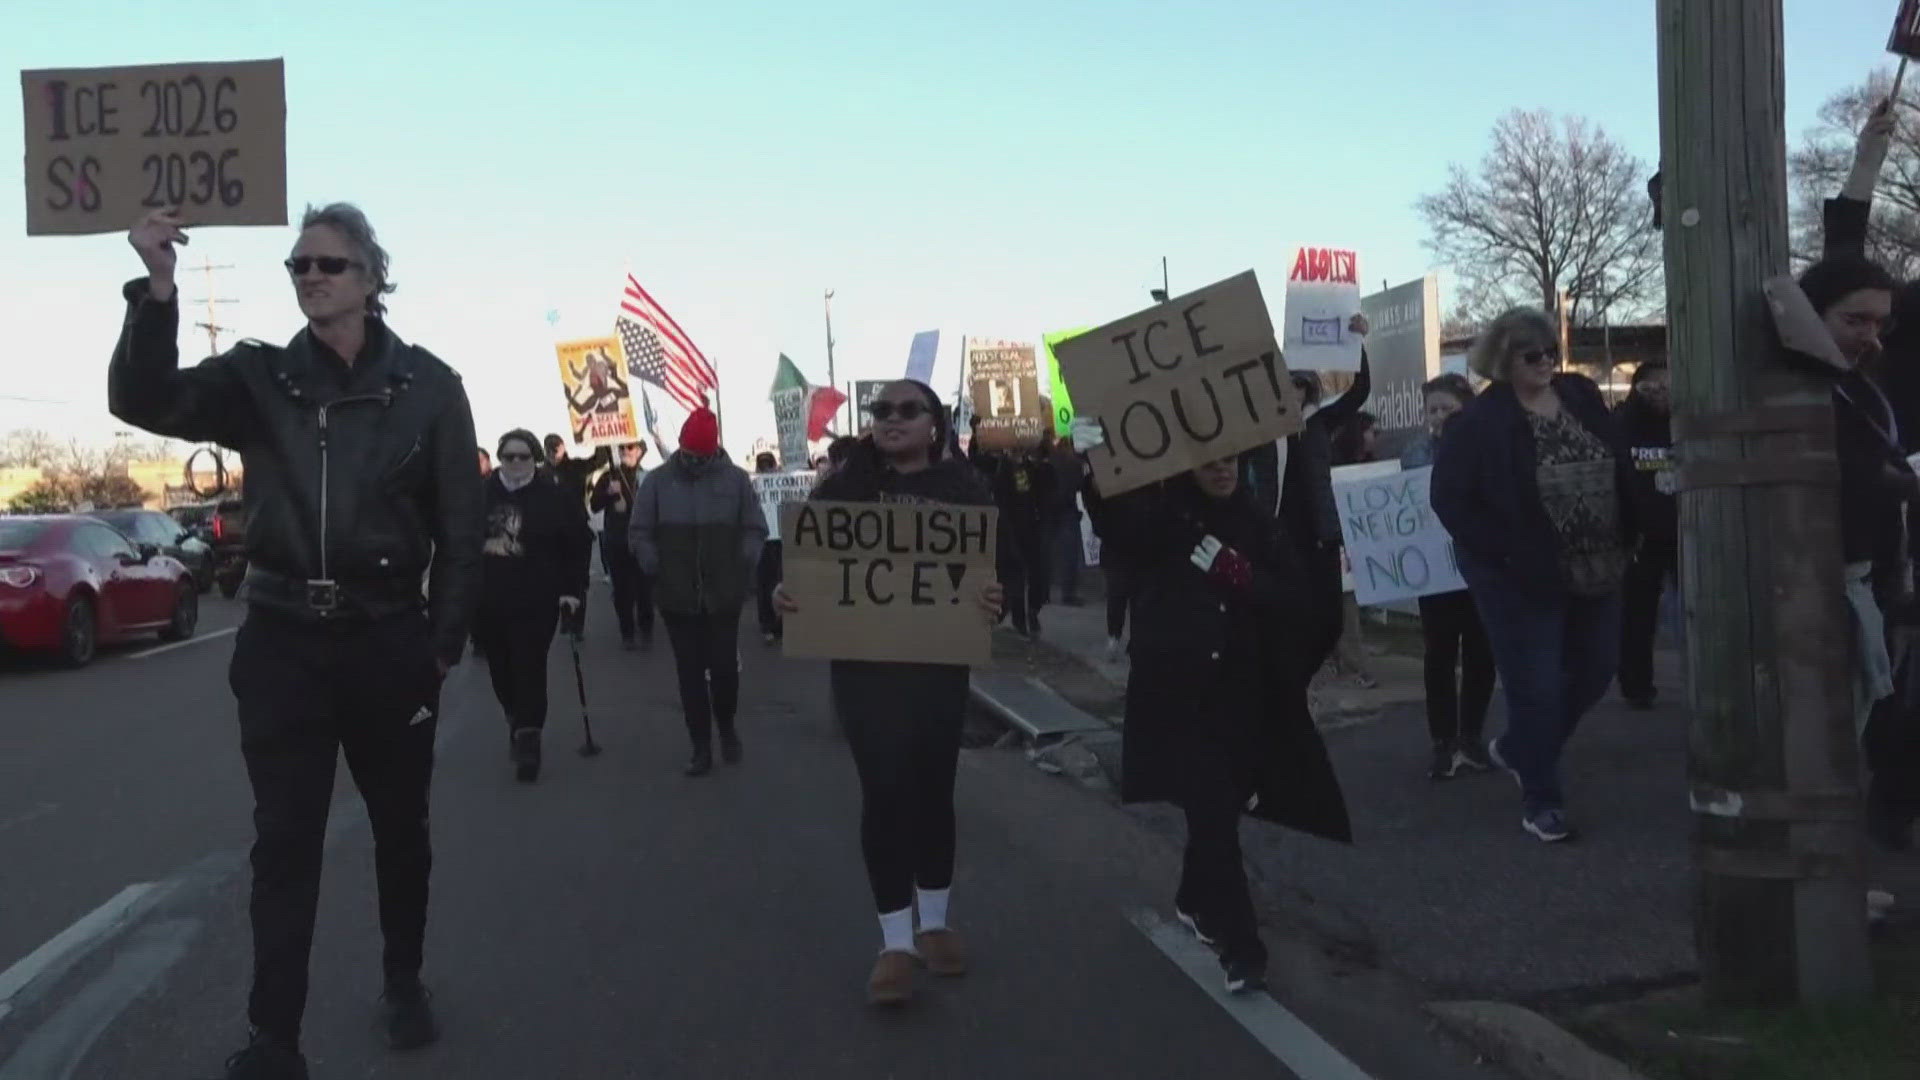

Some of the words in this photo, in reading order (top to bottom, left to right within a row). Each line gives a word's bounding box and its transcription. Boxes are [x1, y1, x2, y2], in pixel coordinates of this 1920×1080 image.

[47, 79, 120, 142] ICE
[140, 74, 238, 138] 2026
[46, 155, 102, 213] SS
[141, 148, 244, 208] 2036
[1112, 300, 1224, 385] ICE
[1372, 379, 1425, 431] vailable
[794, 506, 989, 554] ABOLISH
[837, 558, 967, 606] ICE!
